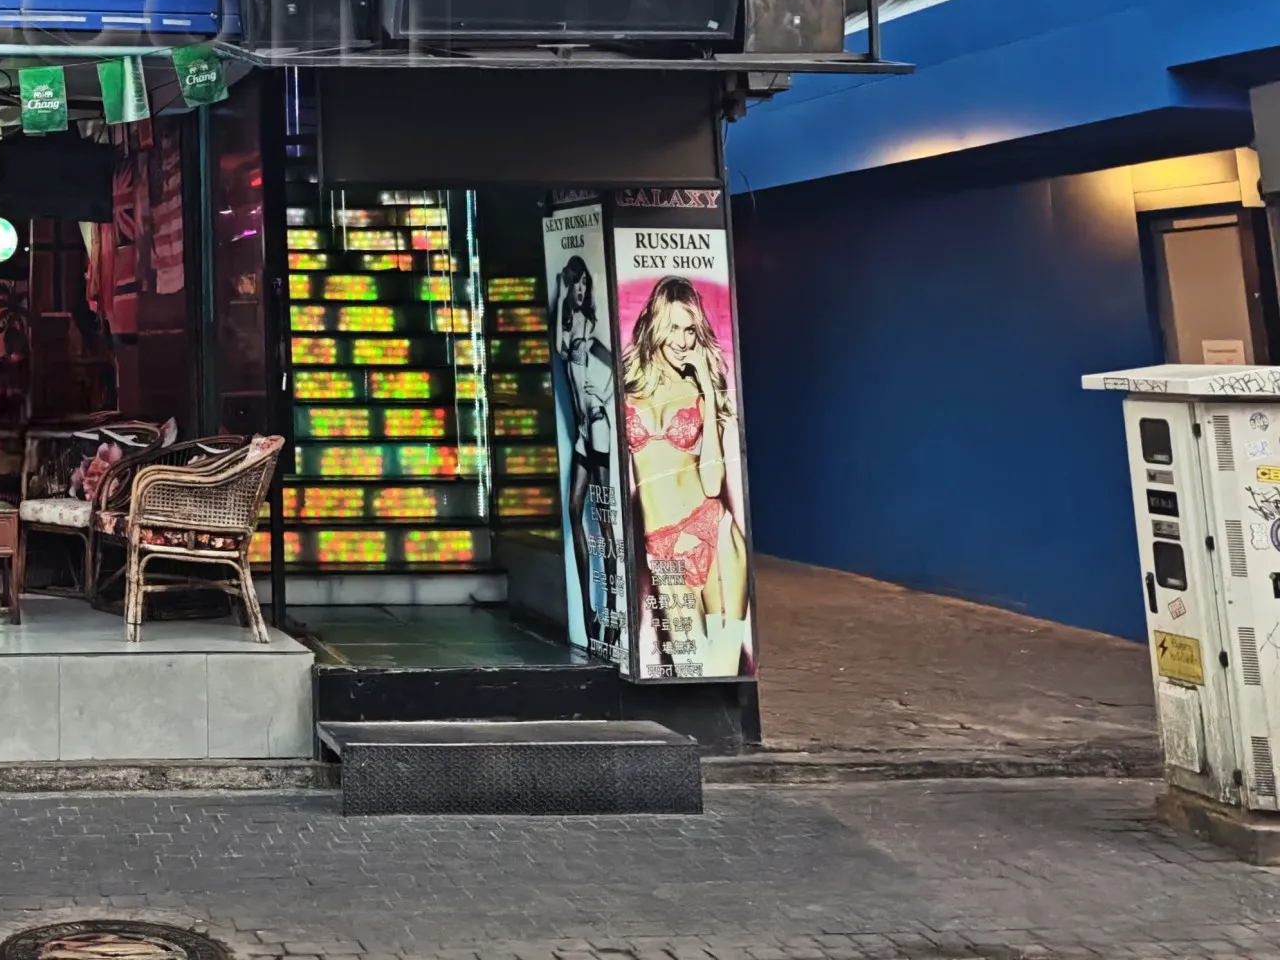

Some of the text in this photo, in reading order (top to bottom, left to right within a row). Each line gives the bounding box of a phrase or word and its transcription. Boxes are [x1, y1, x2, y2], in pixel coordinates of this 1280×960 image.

[186, 71, 218, 87] Chang
[27, 97, 60, 112] Chang
[616, 188, 720, 209] GALAXY
[545, 212, 600, 233] SEXY RUSSIAN
[561, 235, 585, 249] GIRLS
[635, 232, 711, 250] RUSSIAN
[633, 255, 715, 270] SEXY SHOW
[589, 484, 617, 506] FREE
[591, 507, 618, 526] ENTRY
[651, 560, 686, 574] FREE
[652, 575, 687, 586] ENTRY
[646, 593, 697, 610] 免費入場
